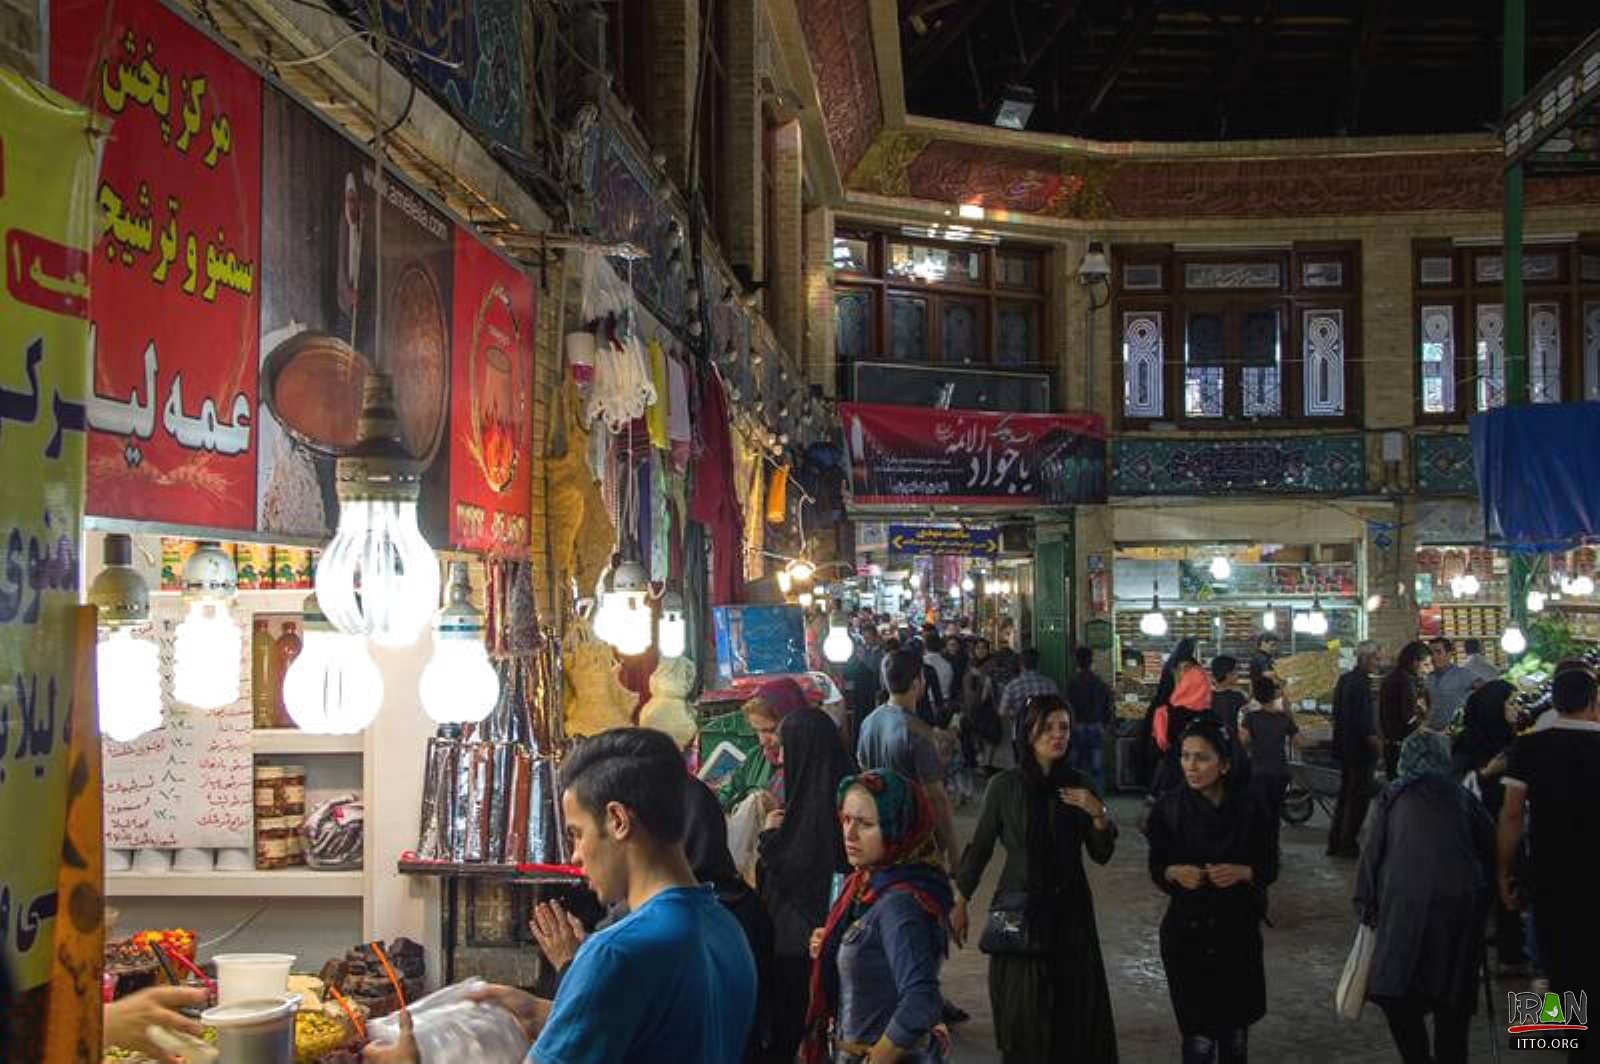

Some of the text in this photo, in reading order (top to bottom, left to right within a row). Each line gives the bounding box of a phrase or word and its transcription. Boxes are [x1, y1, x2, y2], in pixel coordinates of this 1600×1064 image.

[102, 30, 171, 145] پخش
[182, 232, 198, 295] و
[202, 226, 253, 303] سمنو
[164, 369, 250, 456] عمه
